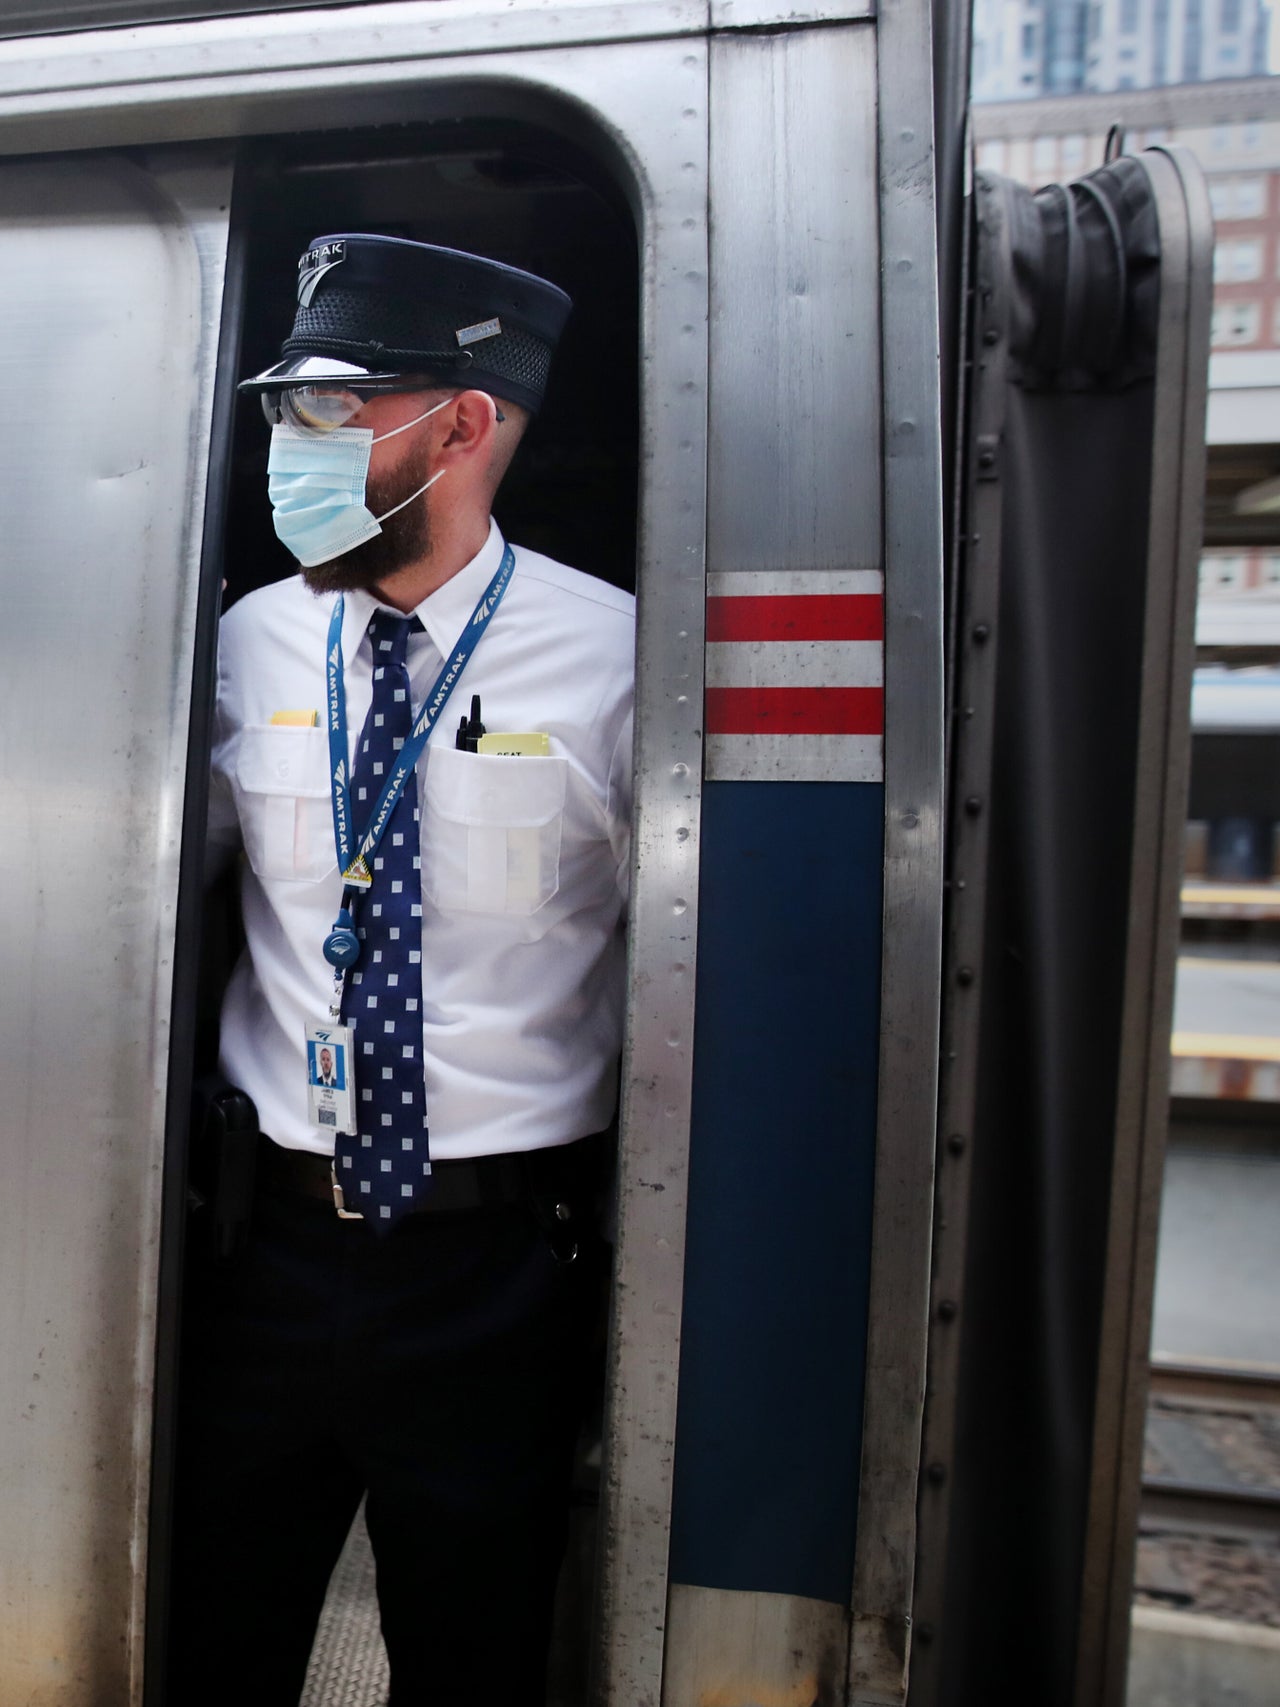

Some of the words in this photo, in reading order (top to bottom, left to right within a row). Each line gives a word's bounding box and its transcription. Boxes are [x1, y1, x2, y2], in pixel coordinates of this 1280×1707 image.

[298, 243, 343, 269] MTRAK
[328, 666, 340, 732] AMTRAK
[429, 652, 466, 718] AMTRAK
[334, 785, 349, 855] AMTRAK
[373, 767, 407, 835] AMTRAK
